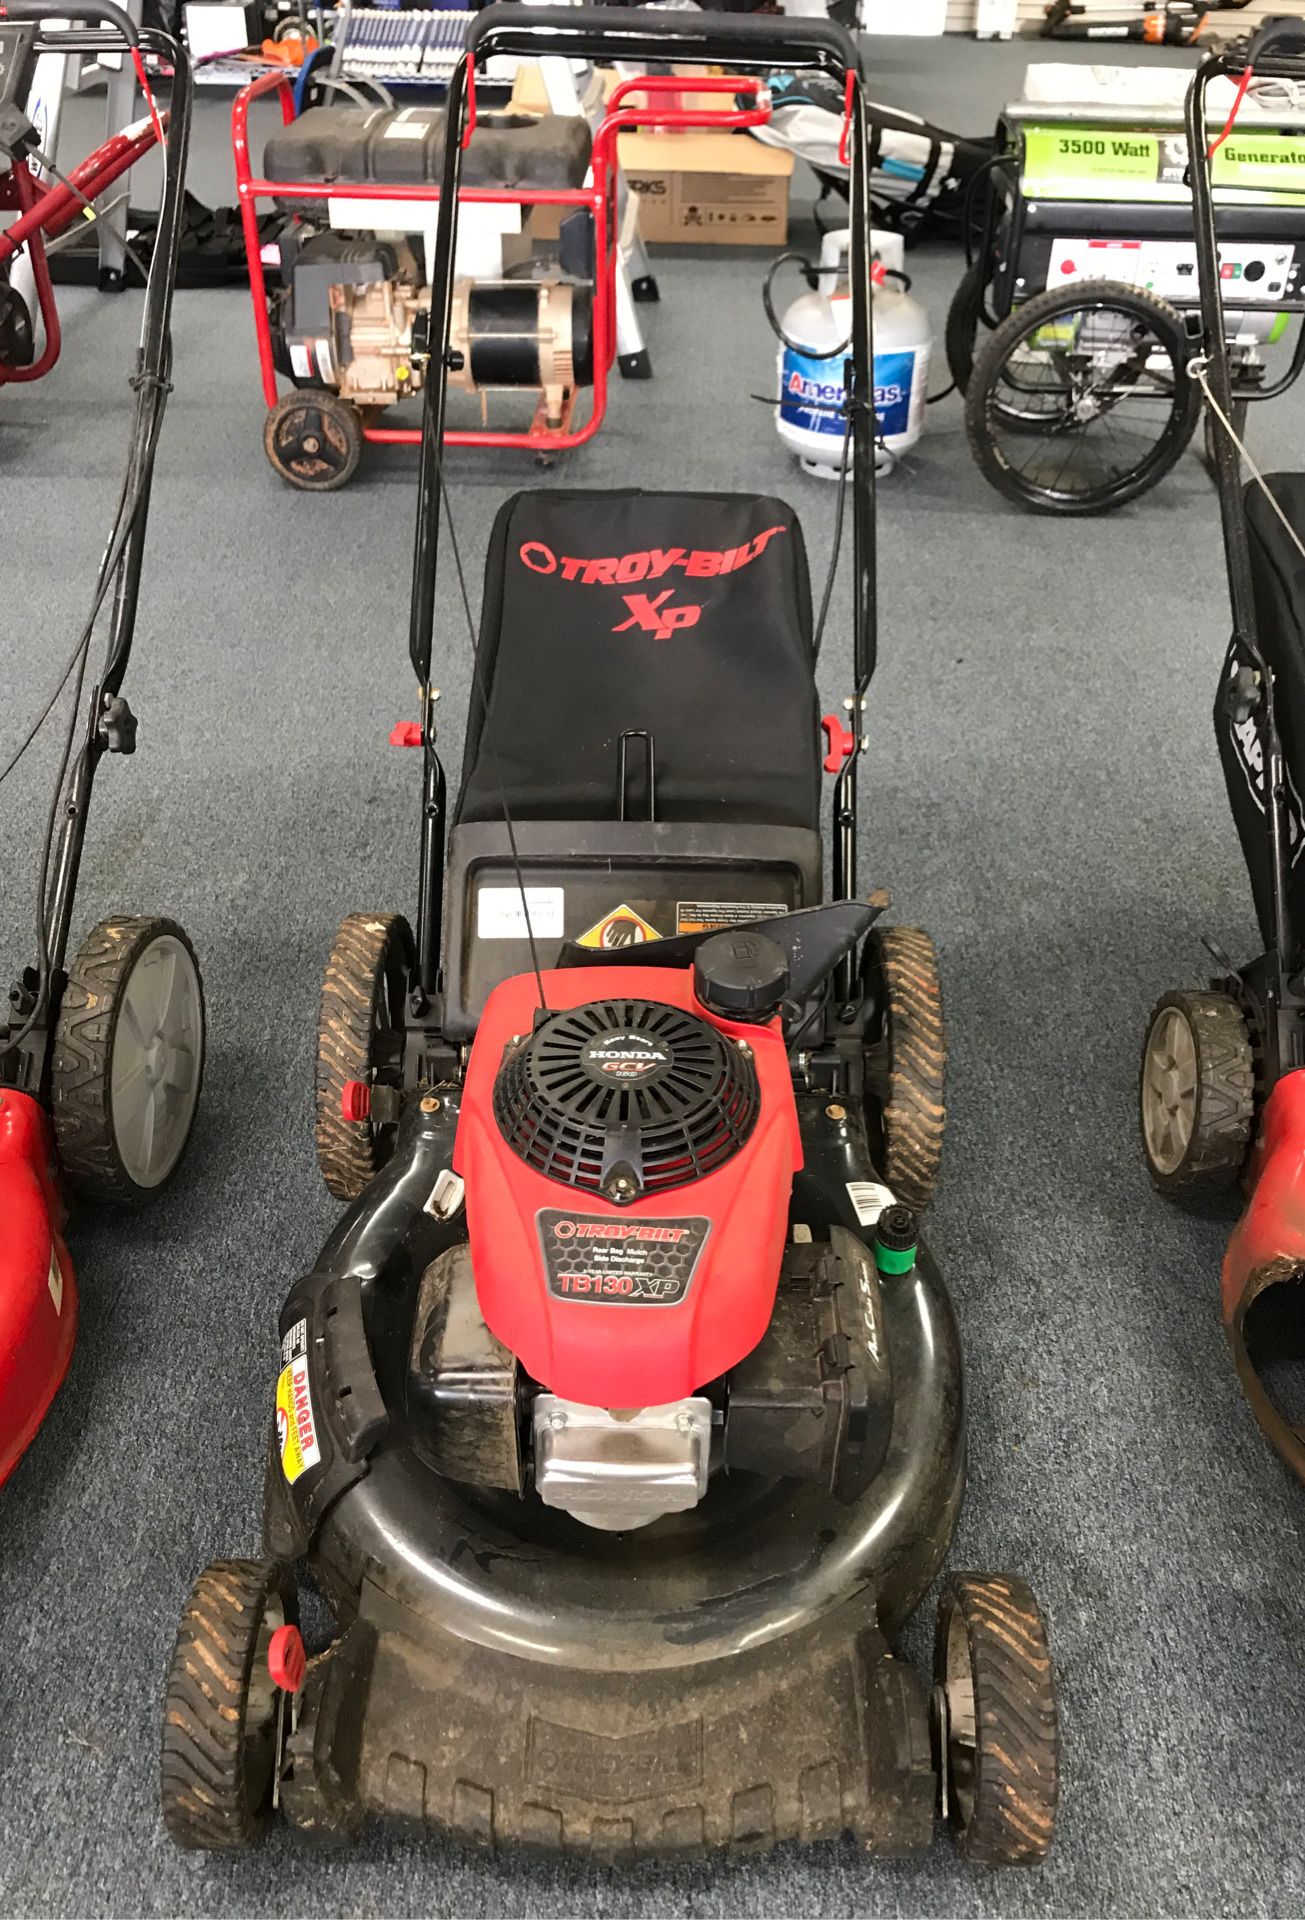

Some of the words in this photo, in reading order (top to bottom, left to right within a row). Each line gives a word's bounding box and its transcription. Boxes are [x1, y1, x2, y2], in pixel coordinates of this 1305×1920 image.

[1059, 139, 1106, 155] 3500
[1111, 141, 1151, 158] Watt
[560, 526, 786, 585] TROY-BILT
[589, 1050, 667, 1061] HONDA
[602, 1062, 657, 1072] GCV
[576, 1223, 685, 1243] TROY-BILT
[593, 1254, 610, 1262] Side
[610, 1255, 645, 1264] Discharge
[610, 1247, 624, 1255] Bag
[626, 1248, 648, 1256] Mulch
[557, 1273, 634, 1294] TB130
[287, 1387, 295, 1412] HANDS
[293, 1370, 314, 1452] DANGER
[290, 1427, 299, 1446] FEET
[294, 1446, 304, 1469] AWAY
